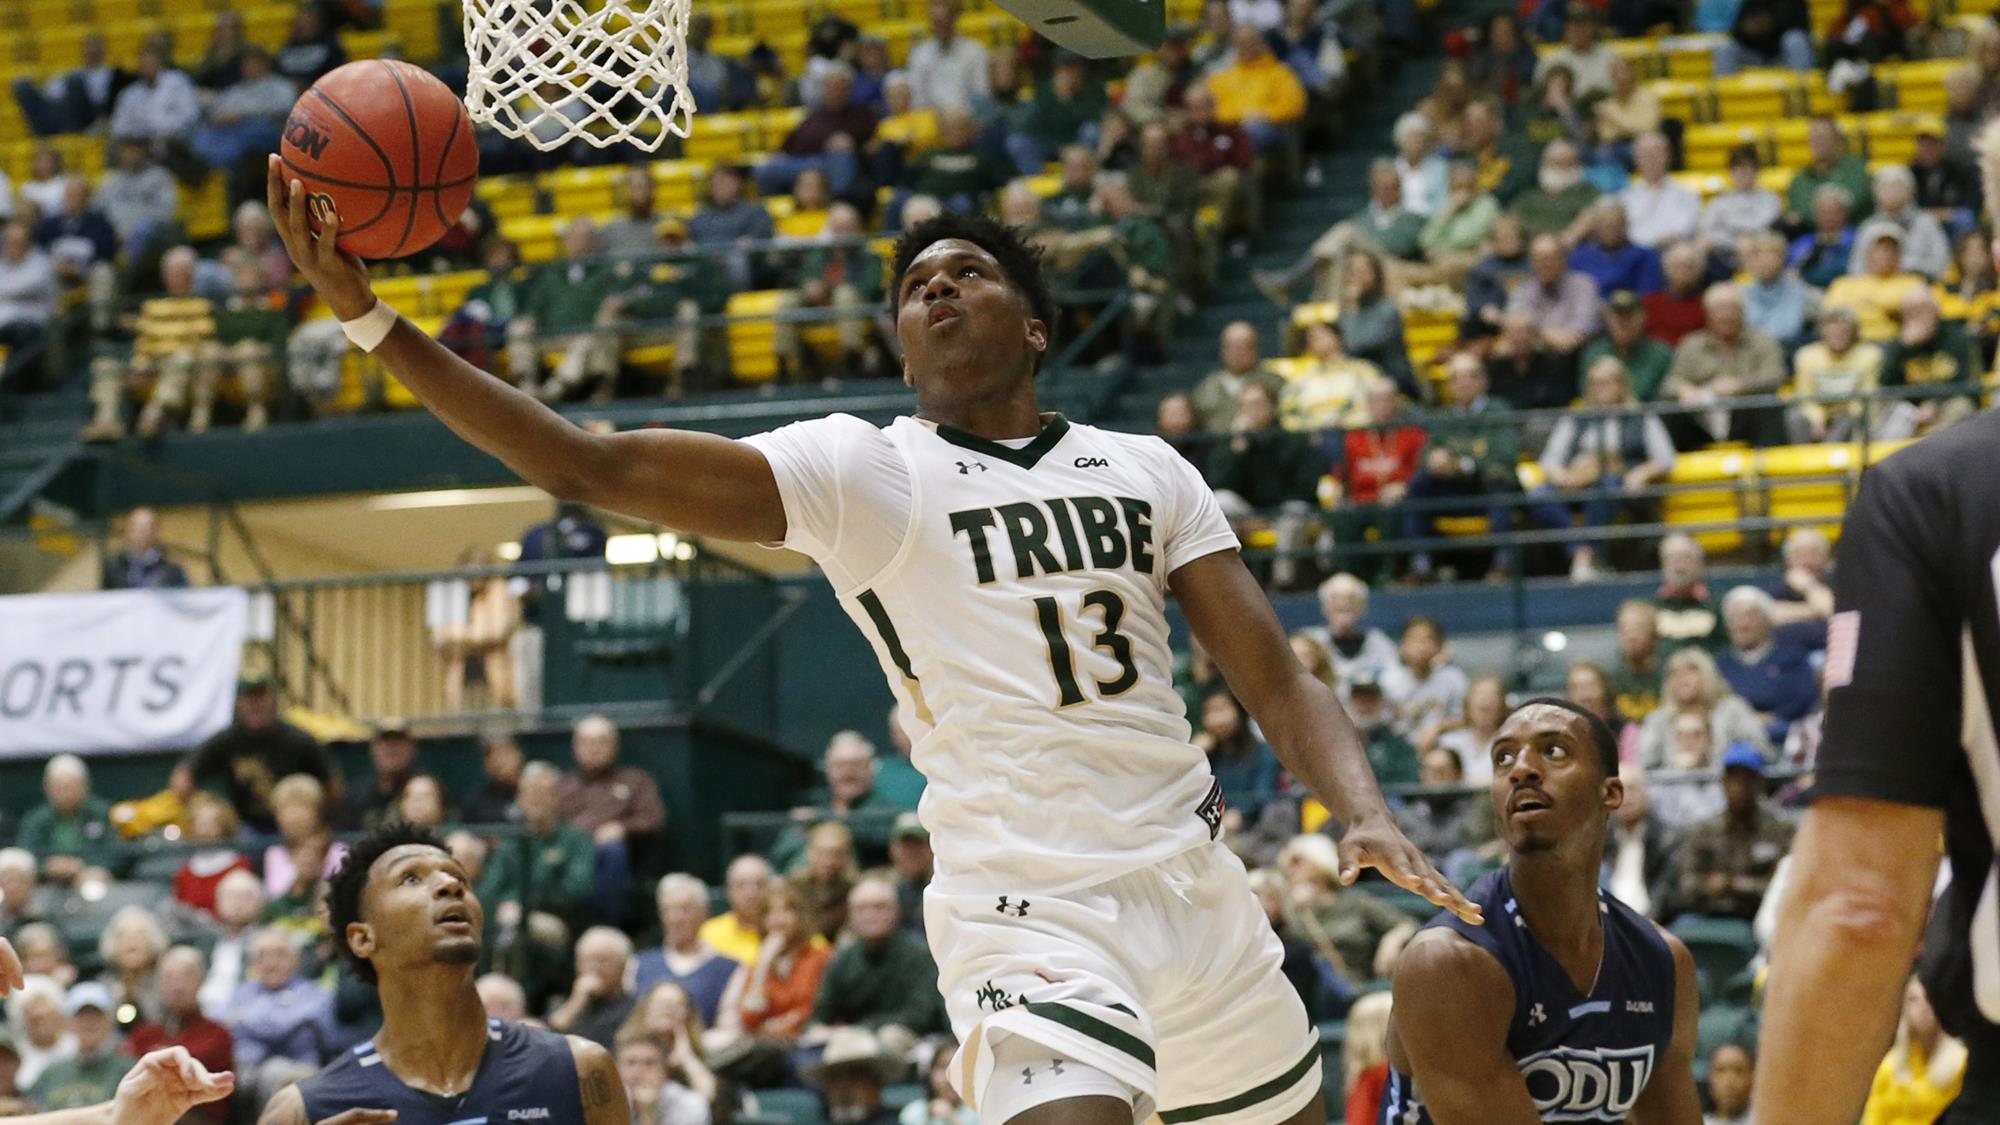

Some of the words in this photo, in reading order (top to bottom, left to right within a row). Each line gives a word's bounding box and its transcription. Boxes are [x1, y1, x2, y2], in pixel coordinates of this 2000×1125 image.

[1074, 457, 1109, 468] CAA
[949, 495, 1154, 584] TRIBE
[1032, 588, 1140, 707] 13
[0, 655, 185, 718] ORTS
[1521, 1057, 1646, 1113] ODU
